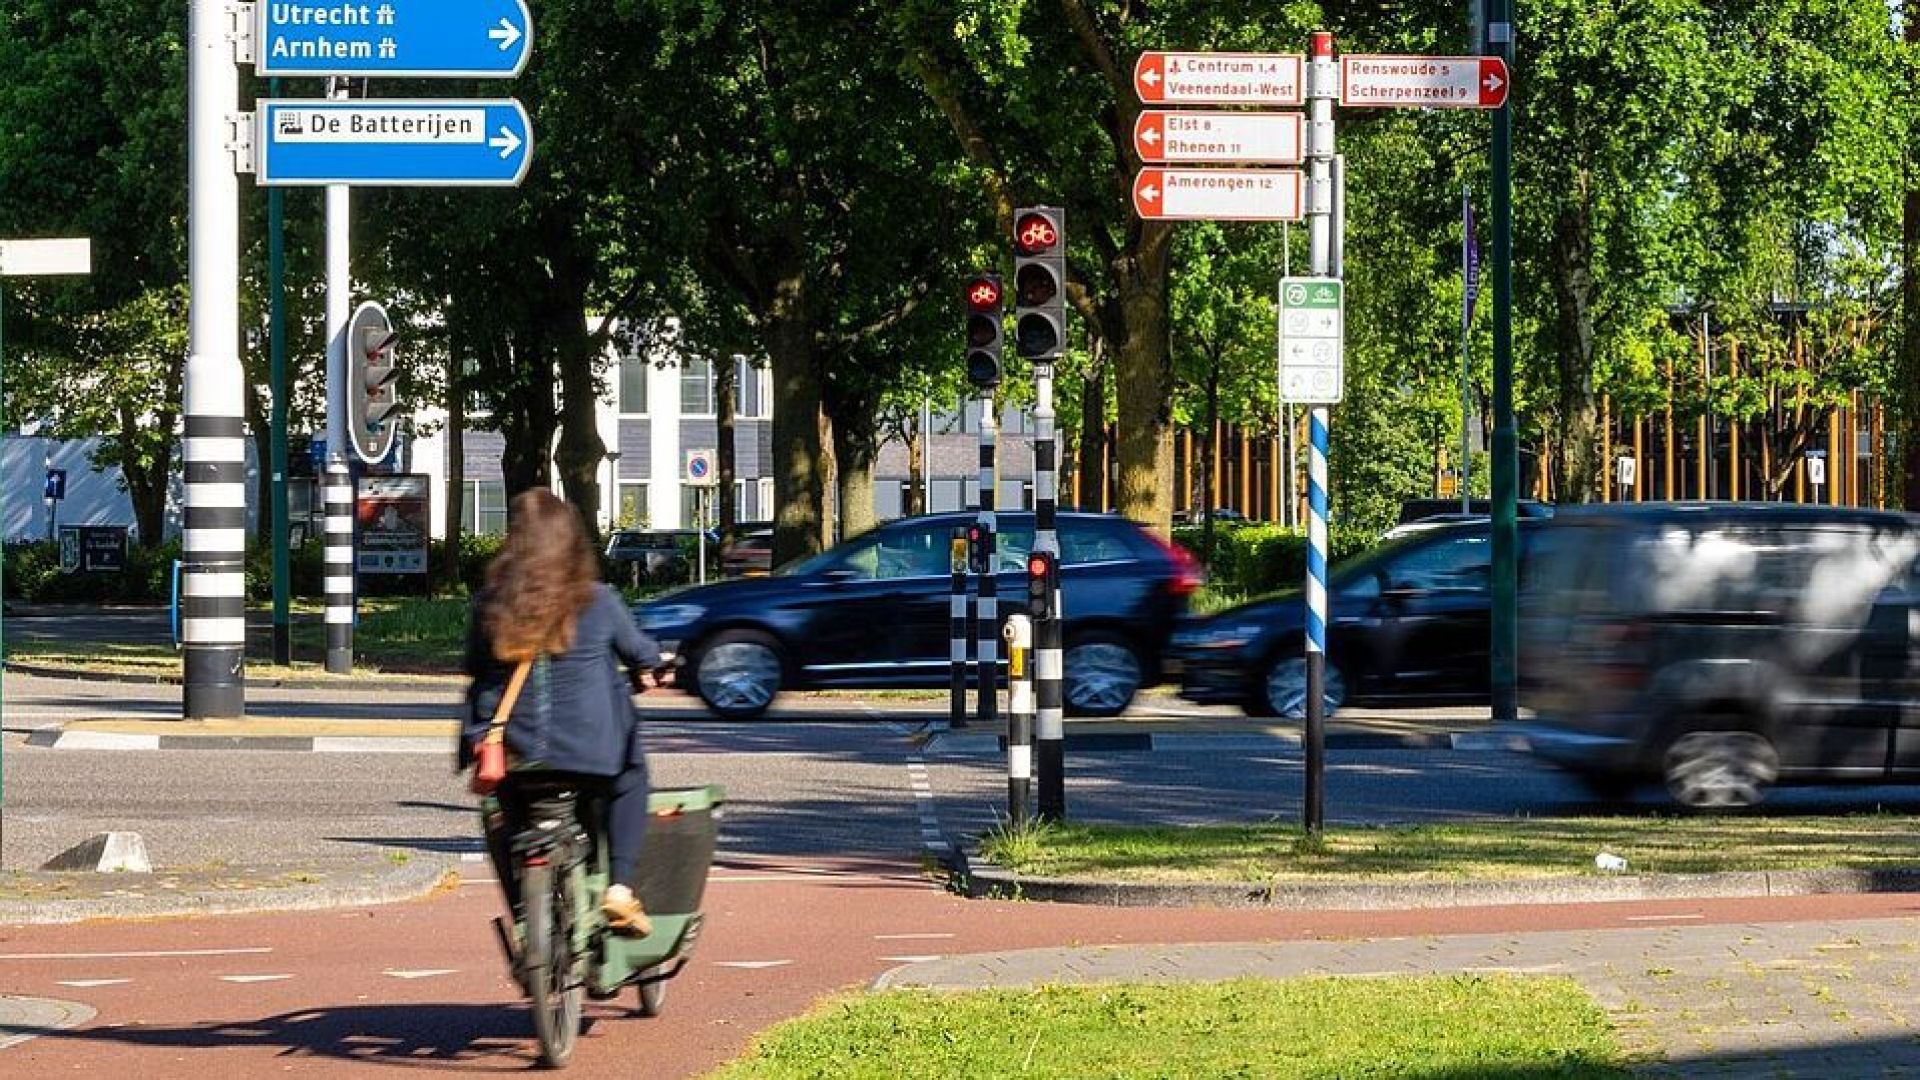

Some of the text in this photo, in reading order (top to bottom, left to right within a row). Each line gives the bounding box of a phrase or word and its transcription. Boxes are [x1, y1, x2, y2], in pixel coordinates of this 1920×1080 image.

[272, 3, 370, 25] Utrecht
[272, 36, 371, 58] Arnhem
[1187, 60, 1277, 75] Centrum 1,4
[1352, 62, 1450, 75] Renswoude 5
[1168, 82, 1293, 95] Veenendaal-West
[1351, 84, 1467, 99] Scherpenzeel 9
[311, 114, 472, 138] De Batterijen
[1168, 118, 1198, 131] Elst
[1167, 140, 1225, 153] Rhenen
[1167, 176, 1272, 192] Amerongen 12
